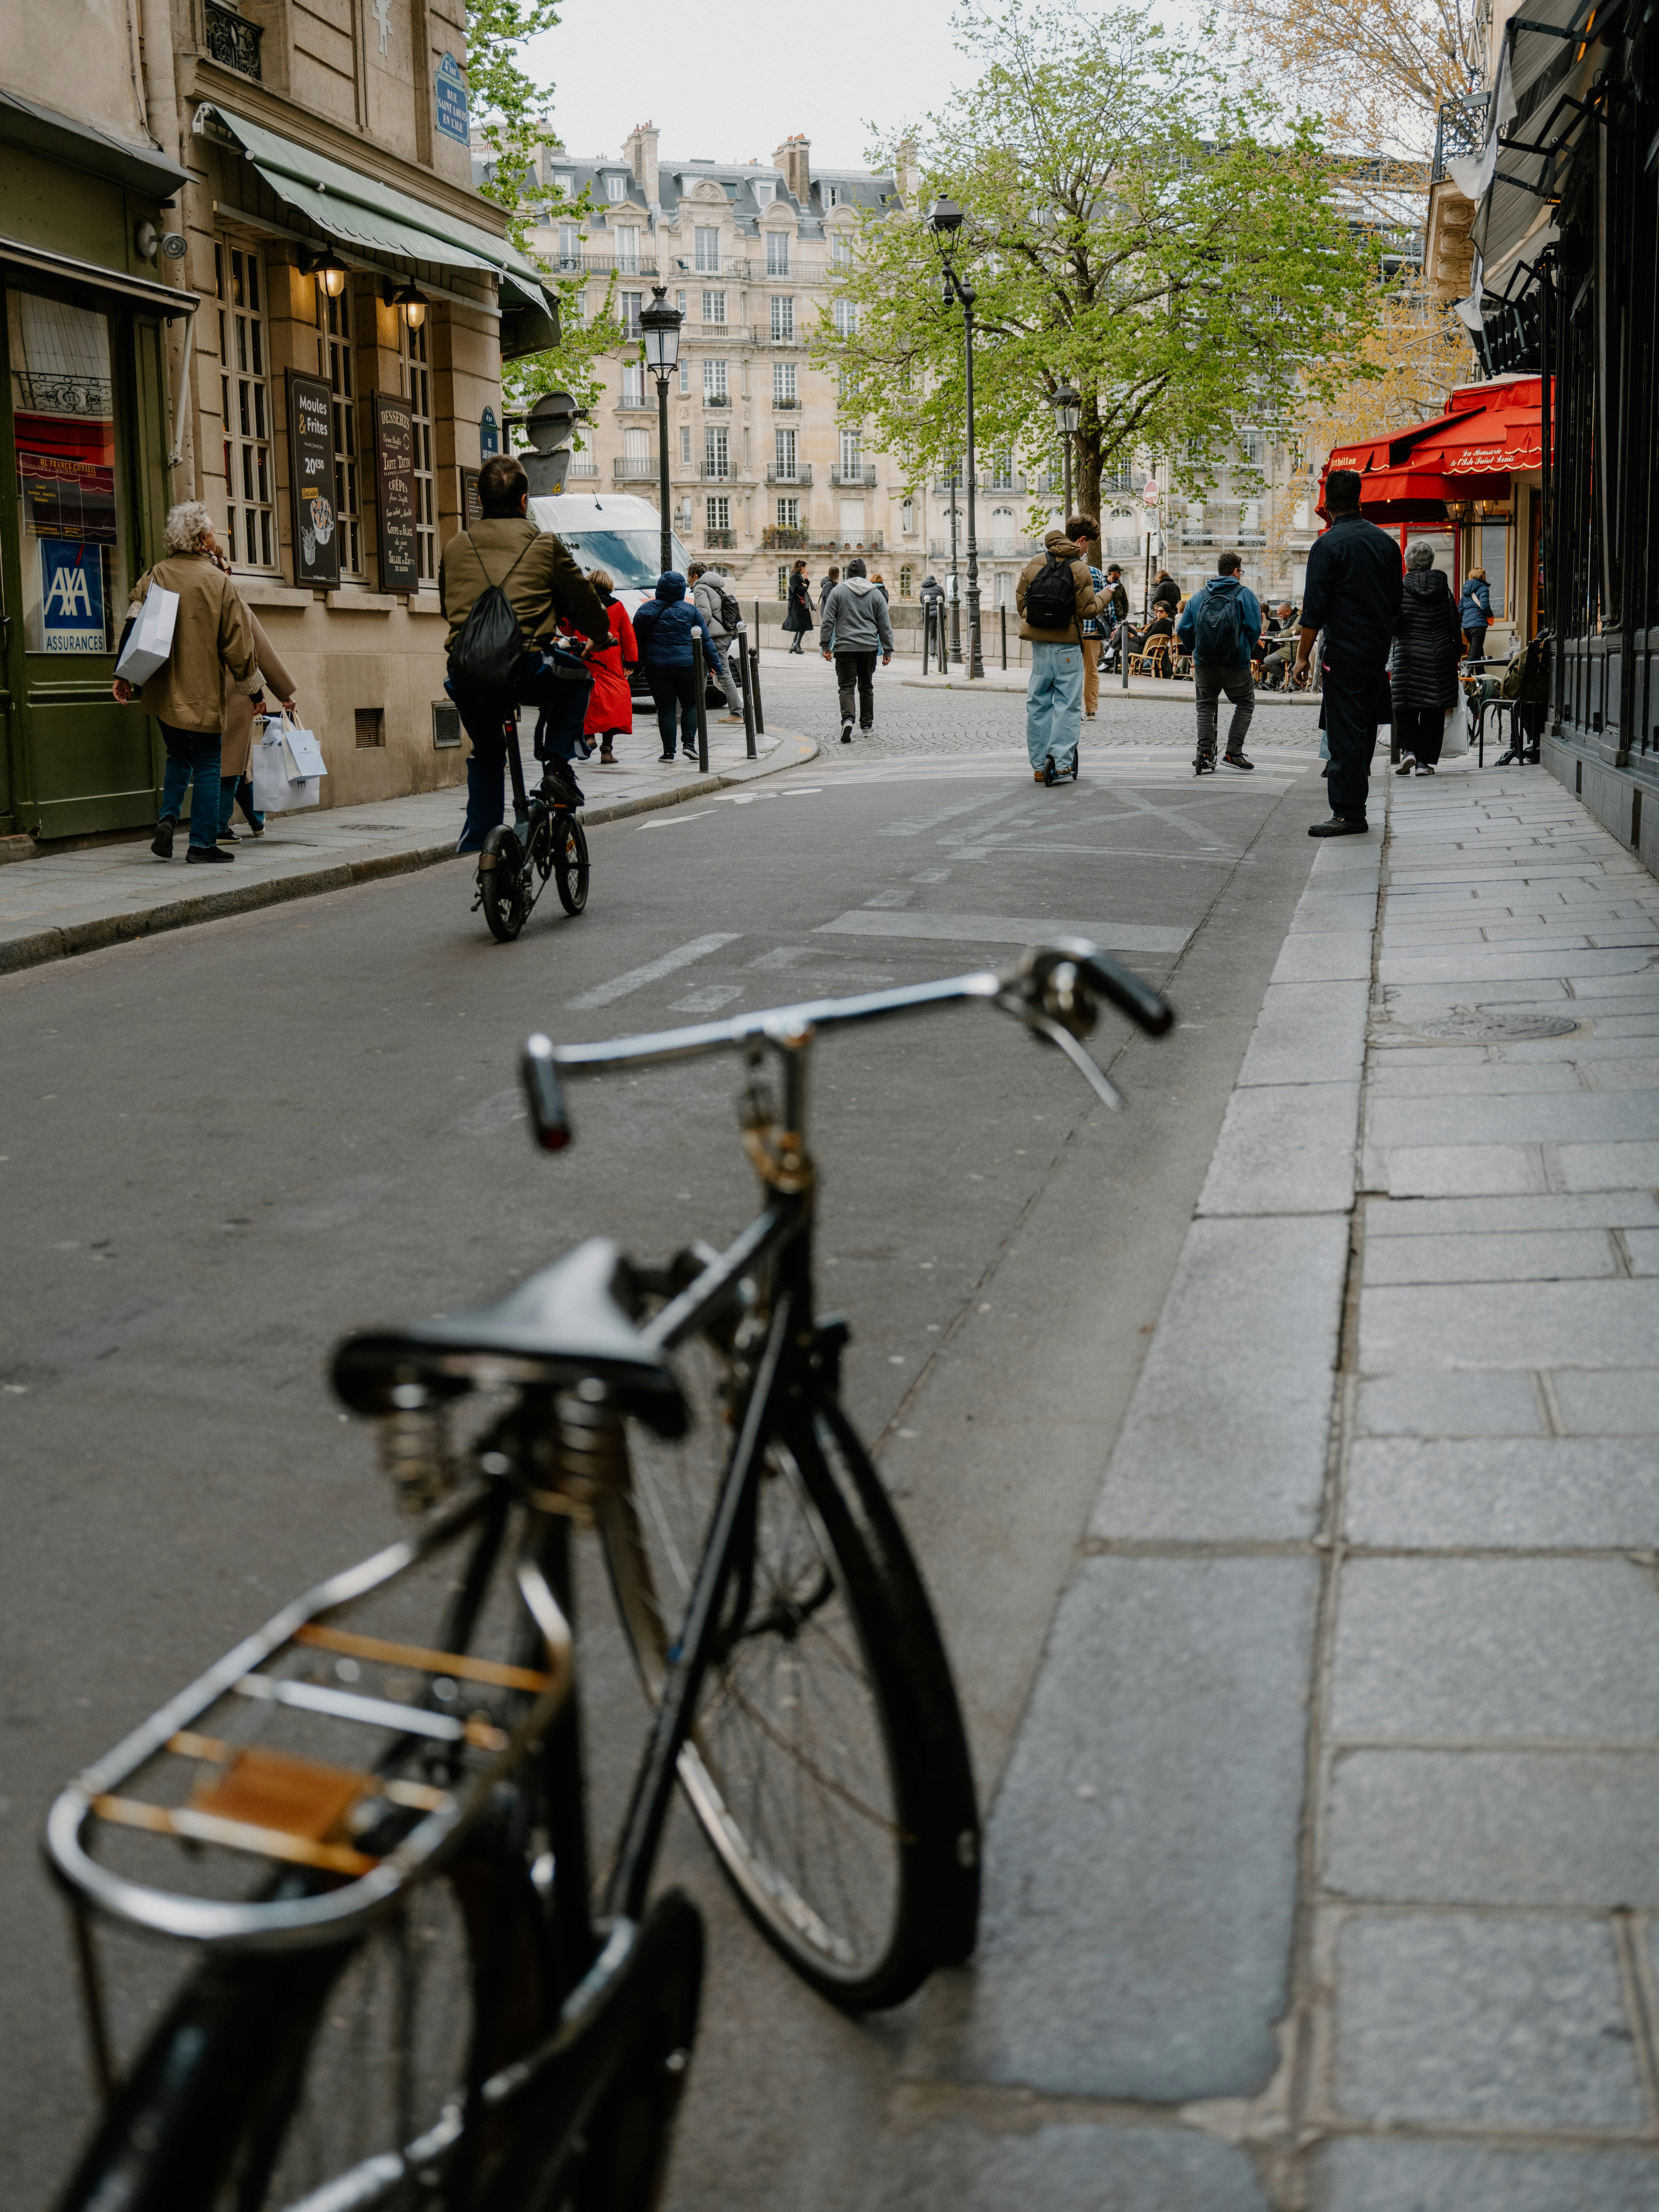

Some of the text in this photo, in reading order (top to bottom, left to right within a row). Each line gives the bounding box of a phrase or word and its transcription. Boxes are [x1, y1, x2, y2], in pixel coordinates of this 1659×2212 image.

[447, 89, 457, 103] RUE
[438, 98, 466, 122] SAINT LOUIS
[443, 114, 449, 126] EN
[300, 394, 327, 415] Moules
[299, 414, 327, 436] & Frites
[381, 410, 409, 430] DESSERTS
[1463, 448, 1502, 457] La Brasserie
[50, 460, 72, 470] FRANCE
[74, 464, 96, 473] CONSEIL
[383, 452, 410, 470] TARTE TATIN
[387, 522, 399, 535] COUPE
[403, 524, 413, 536] GLACE
[395, 537, 407, 552] du jour
[389, 550, 401, 564] SALADE
[44, 567, 92, 616] AXA
[46, 636, 103, 650] ASSURANCES
